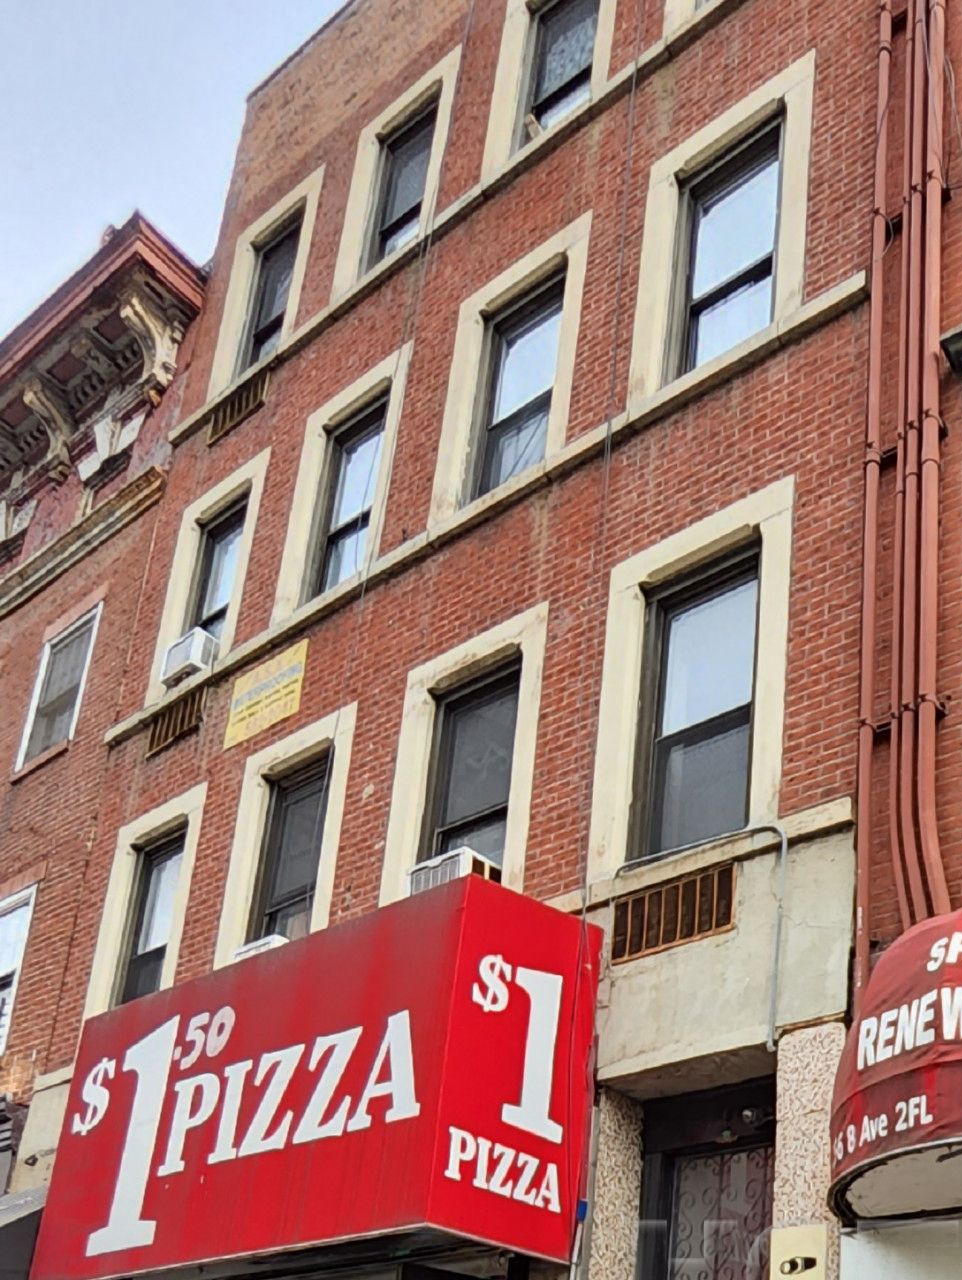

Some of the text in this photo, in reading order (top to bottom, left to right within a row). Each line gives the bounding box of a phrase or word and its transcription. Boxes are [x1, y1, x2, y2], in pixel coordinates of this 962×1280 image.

[157, 1008, 422, 1178] PIZZA
[472, 953, 565, 1146] $1
[444, 1125, 562, 1215] PIZZA
[846, 1124, 856, 1154] 8
[859, 1113, 888, 1148] Ave
[895, 1094, 934, 1132] 2FL
